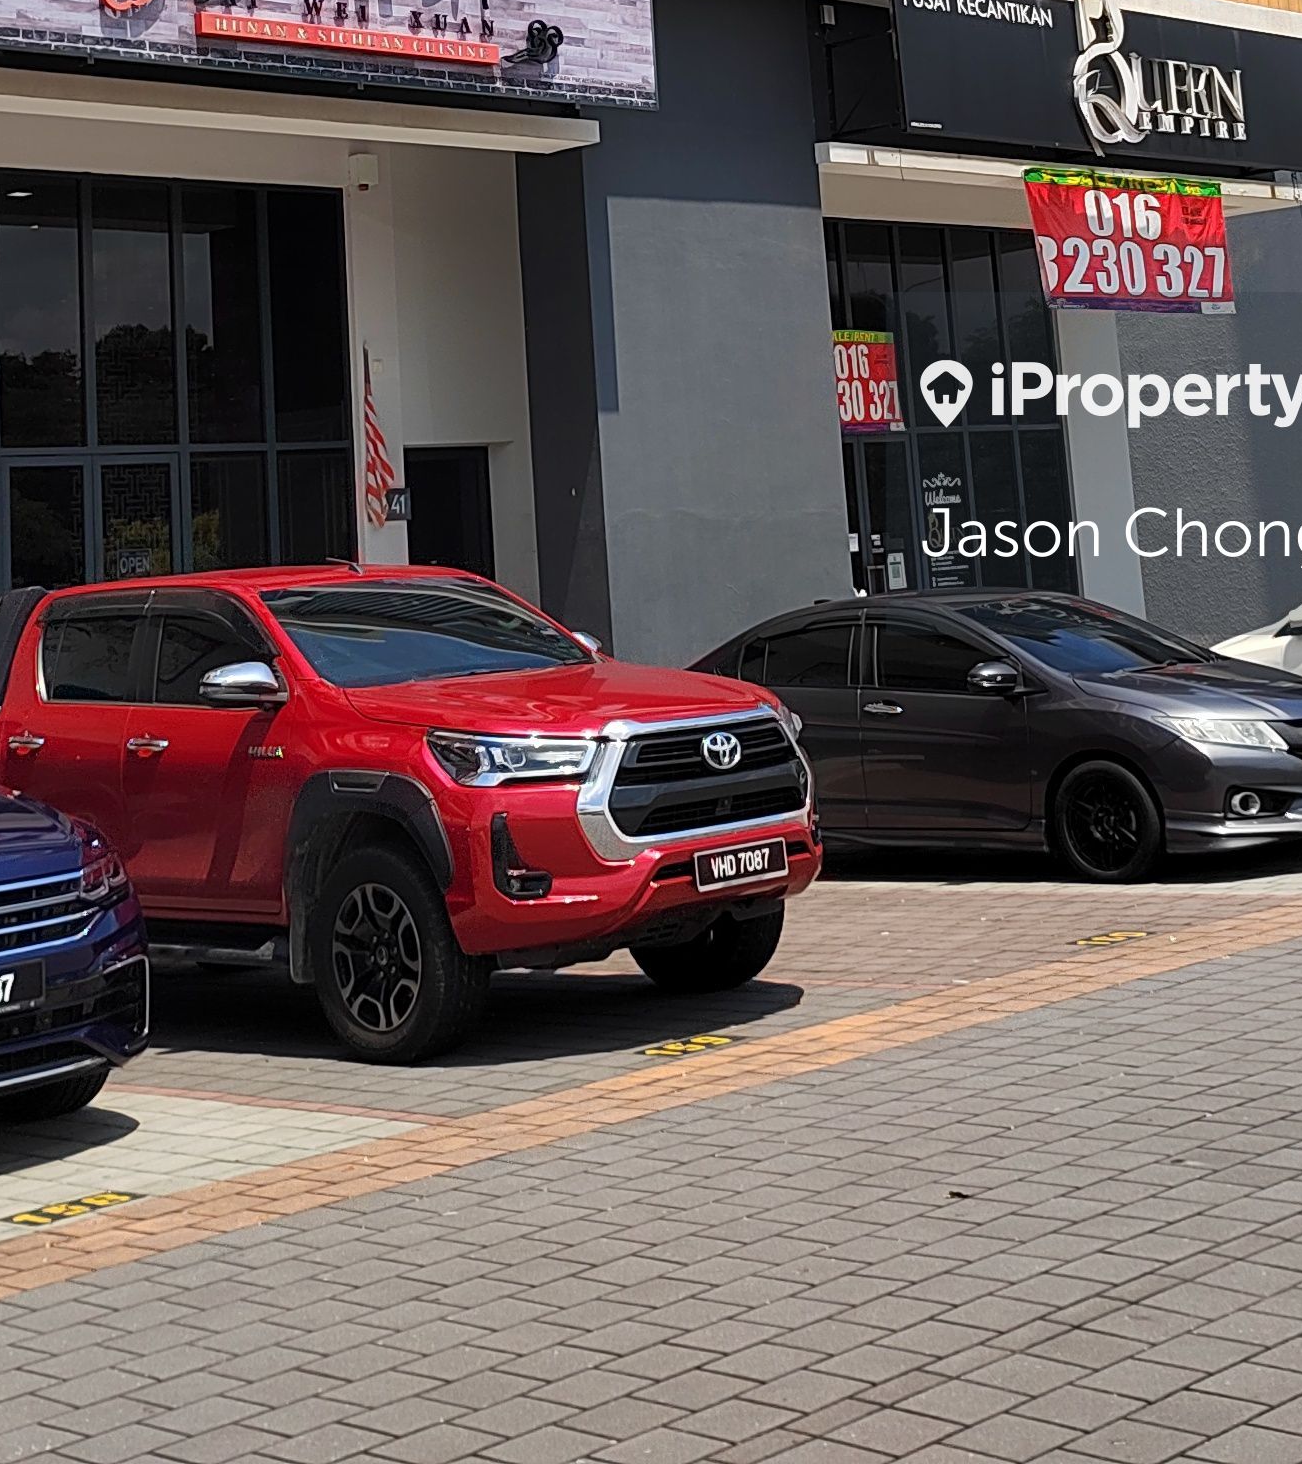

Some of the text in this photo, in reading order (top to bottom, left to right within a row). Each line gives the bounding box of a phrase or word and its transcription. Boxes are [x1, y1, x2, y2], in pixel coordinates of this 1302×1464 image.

[214, 16, 288, 39] HUNAN
[296, 26, 308, 40] &
[413, 39, 489, 61] CUISINE
[409, 10, 495, 38] XUAN
[1138, 111, 1247, 141] EMPIRE
[1084, 189, 1161, 241] 016
[1152, 243, 1225, 298] 327
[834, 344, 870, 380] 016
[924, 488, 962, 507] Welcome
[710, 847, 770, 880] VHD 7087
